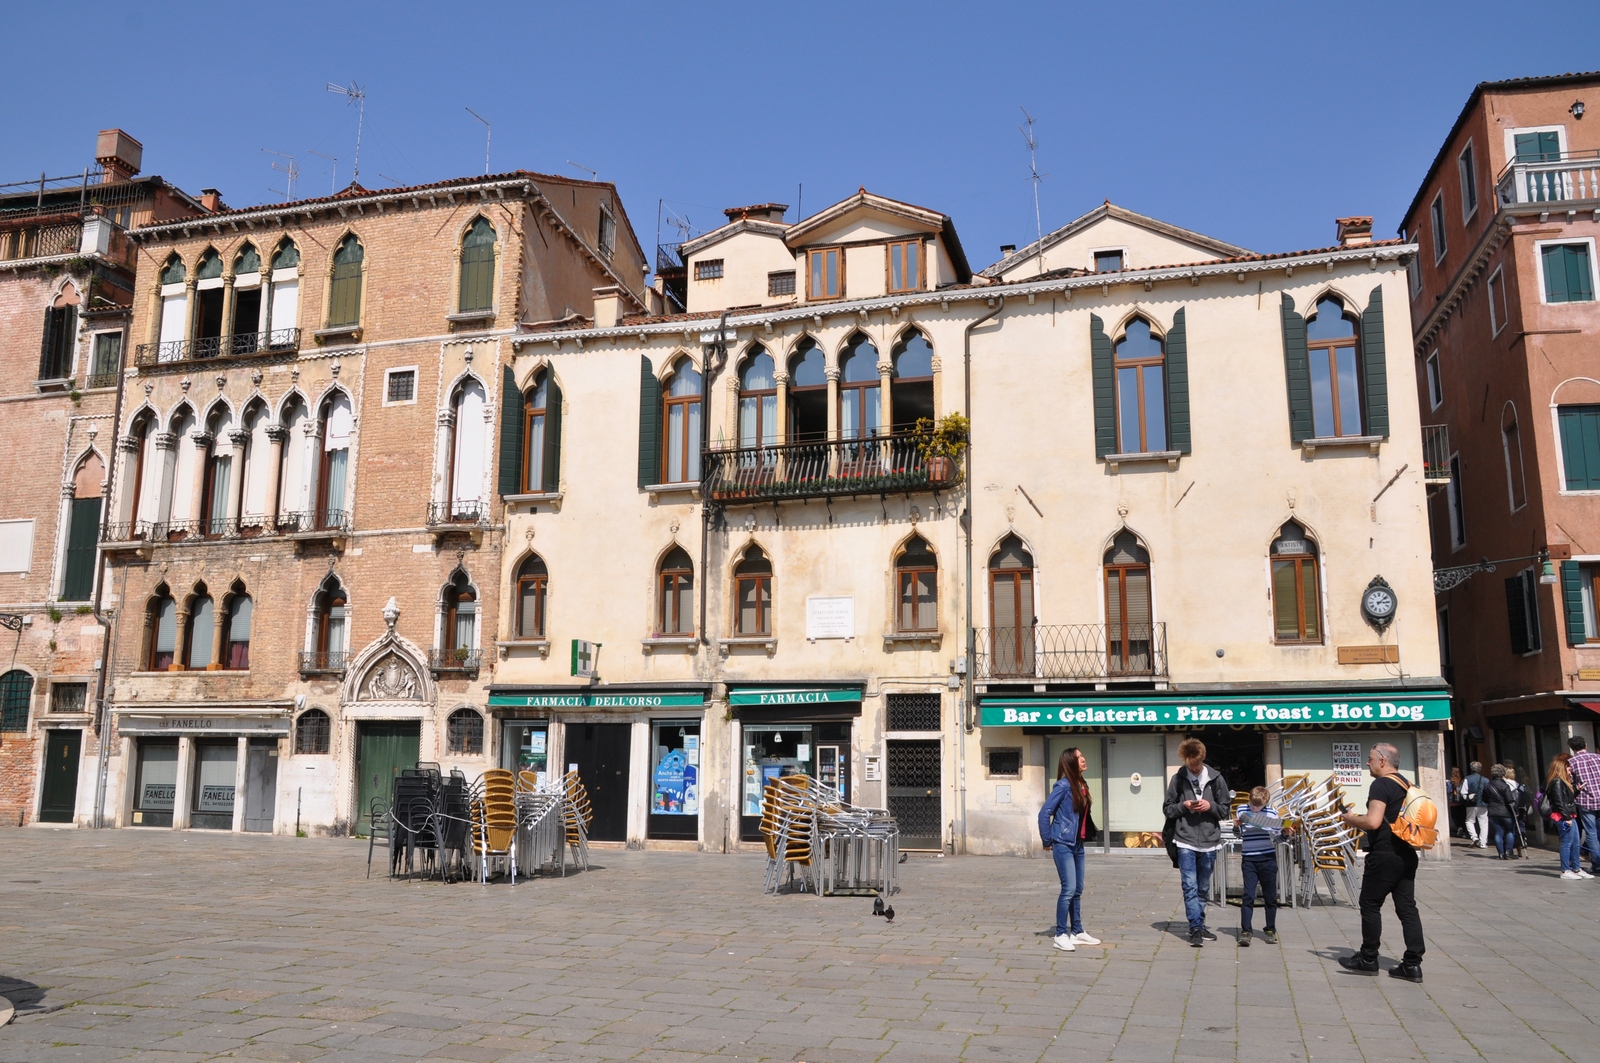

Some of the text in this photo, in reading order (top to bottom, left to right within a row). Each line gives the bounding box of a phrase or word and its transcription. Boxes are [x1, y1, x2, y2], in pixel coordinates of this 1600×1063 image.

[526, 696, 662, 706] FARMACIA DELL'ORSO
[760, 693, 830, 704] FARMACIA
[1004, 702, 1424, 722] Bar Gelateria Pizze Toast Hot Dog
[172, 719, 212, 728] FANELLO
[146, 790, 175, 799] FANELLO
[204, 792, 235, 800] FANELLO
